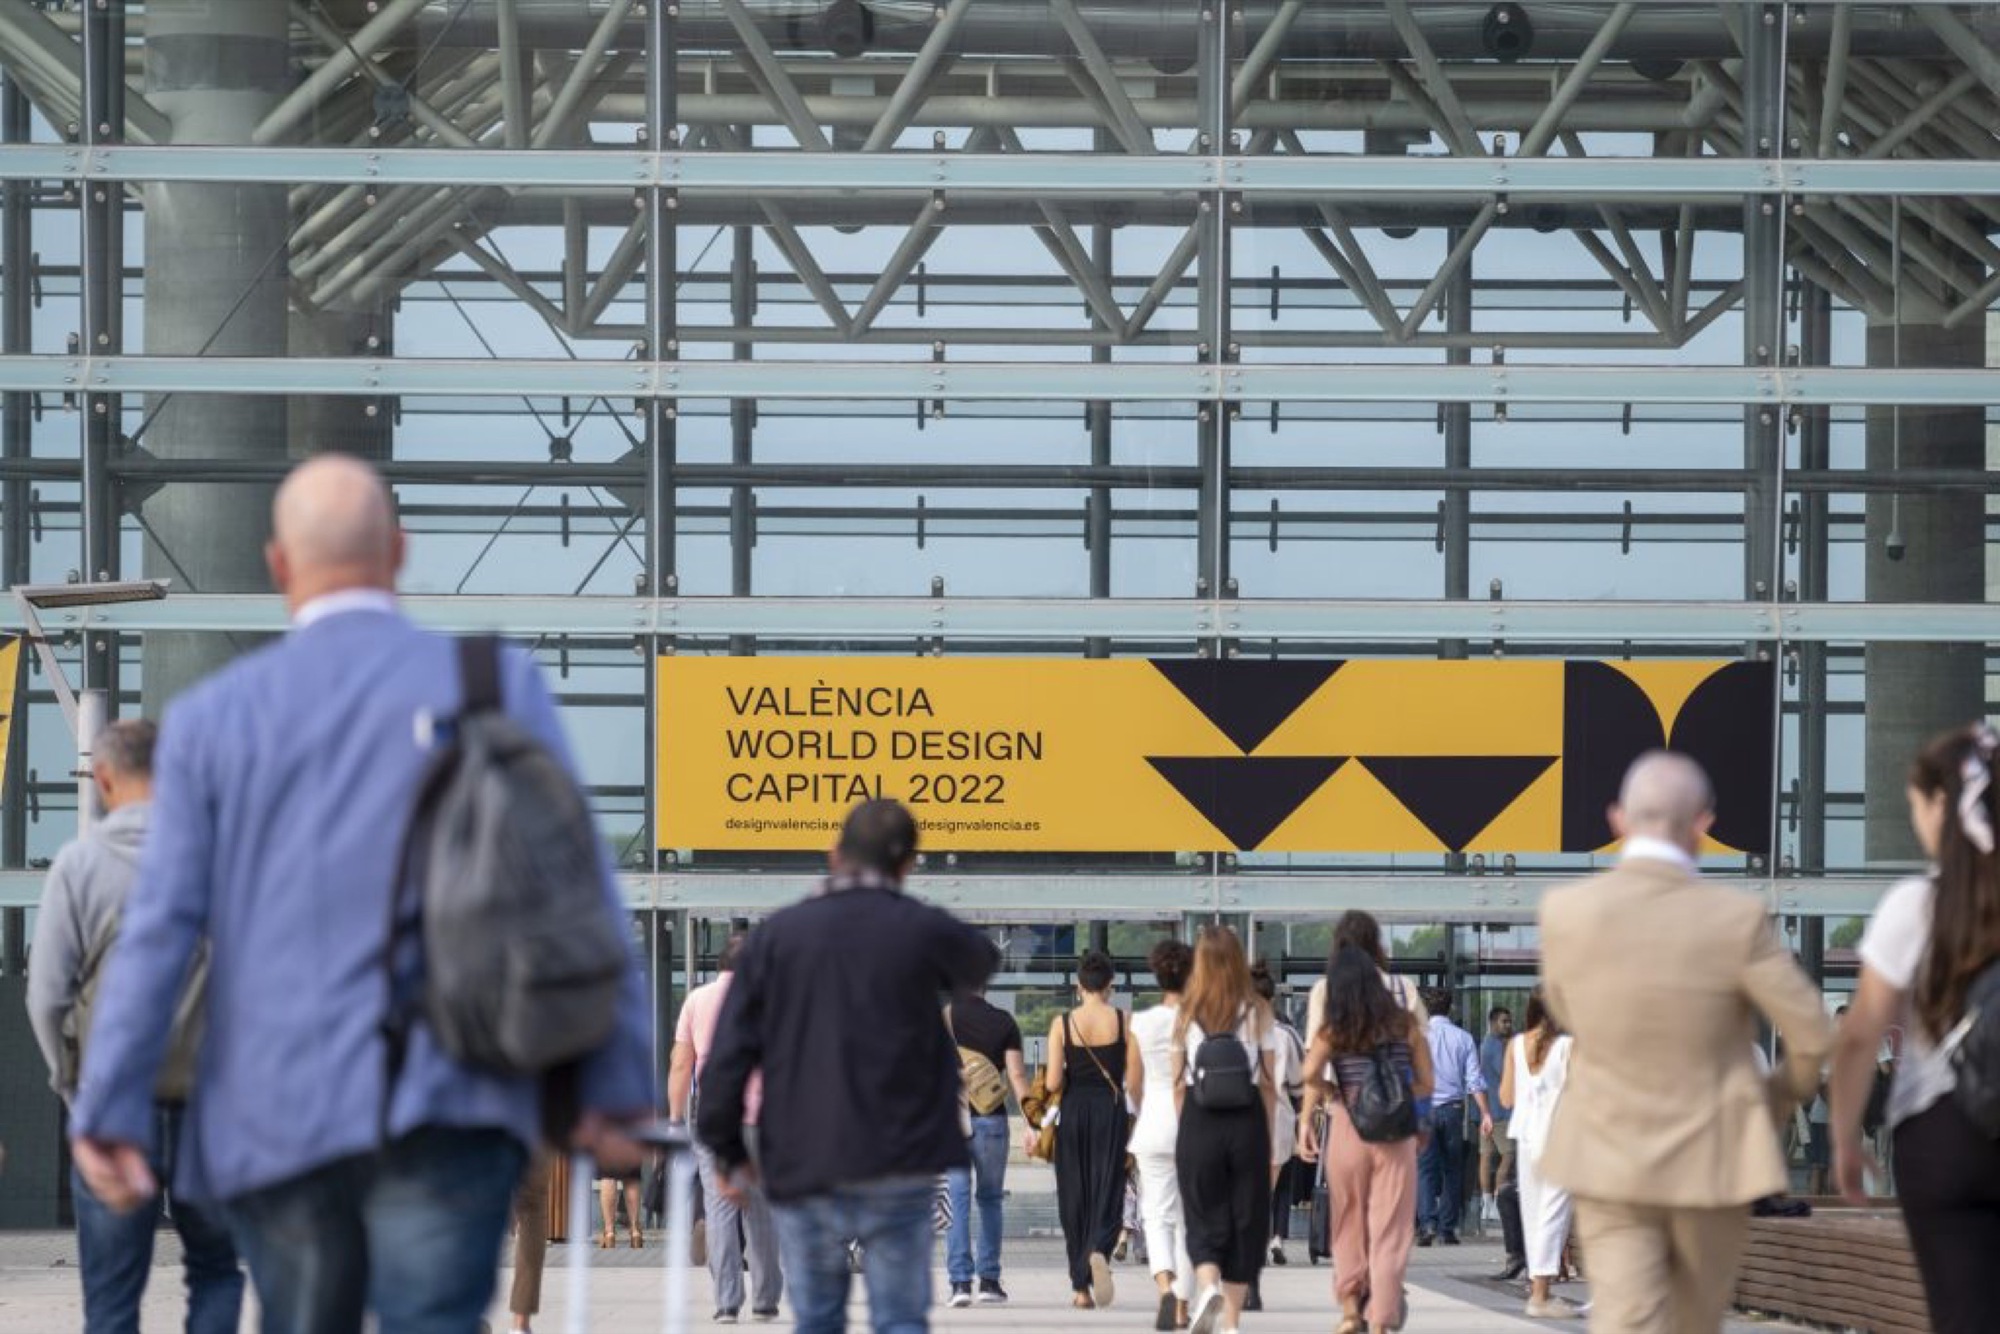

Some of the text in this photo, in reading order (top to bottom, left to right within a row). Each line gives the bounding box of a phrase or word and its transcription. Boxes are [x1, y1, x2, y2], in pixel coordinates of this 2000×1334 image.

[726, 680, 934, 717] VALÈNCIA
[726, 730, 1042, 761] WORLD DESIGN
[726, 773, 1005, 804] CAPITAL 2022
